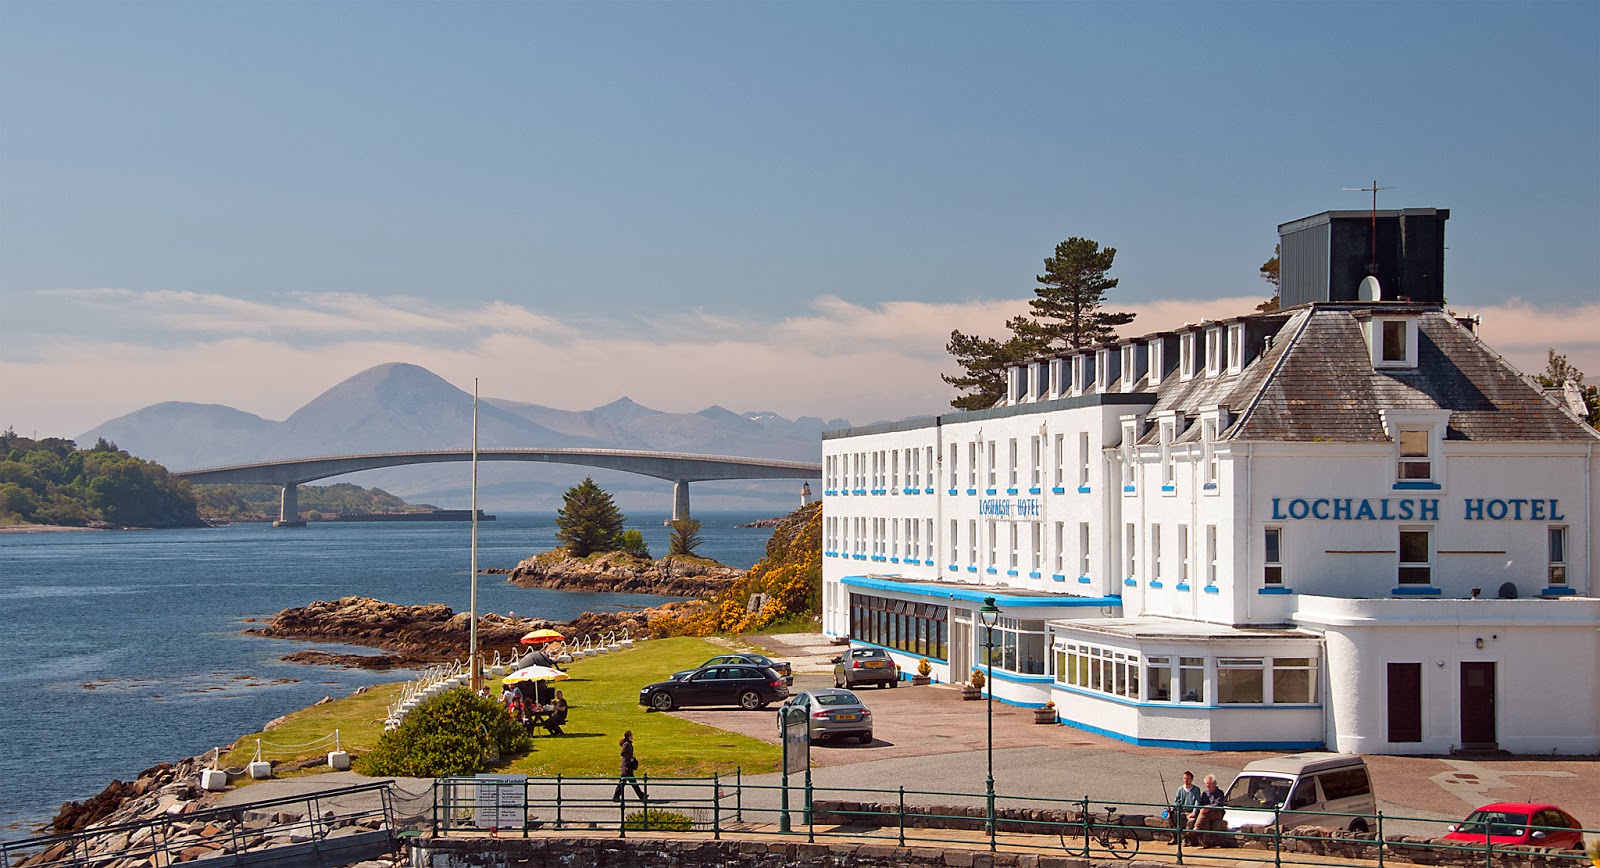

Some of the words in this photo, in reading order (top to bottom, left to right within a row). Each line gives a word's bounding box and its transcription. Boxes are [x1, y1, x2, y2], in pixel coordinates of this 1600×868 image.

[979, 499, 1010, 515] LOCHALSH
[1017, 499, 1039, 516] HOTEL
[1272, 498, 1440, 521] LOCHALSH
[1464, 498, 1565, 521] HOTEL
